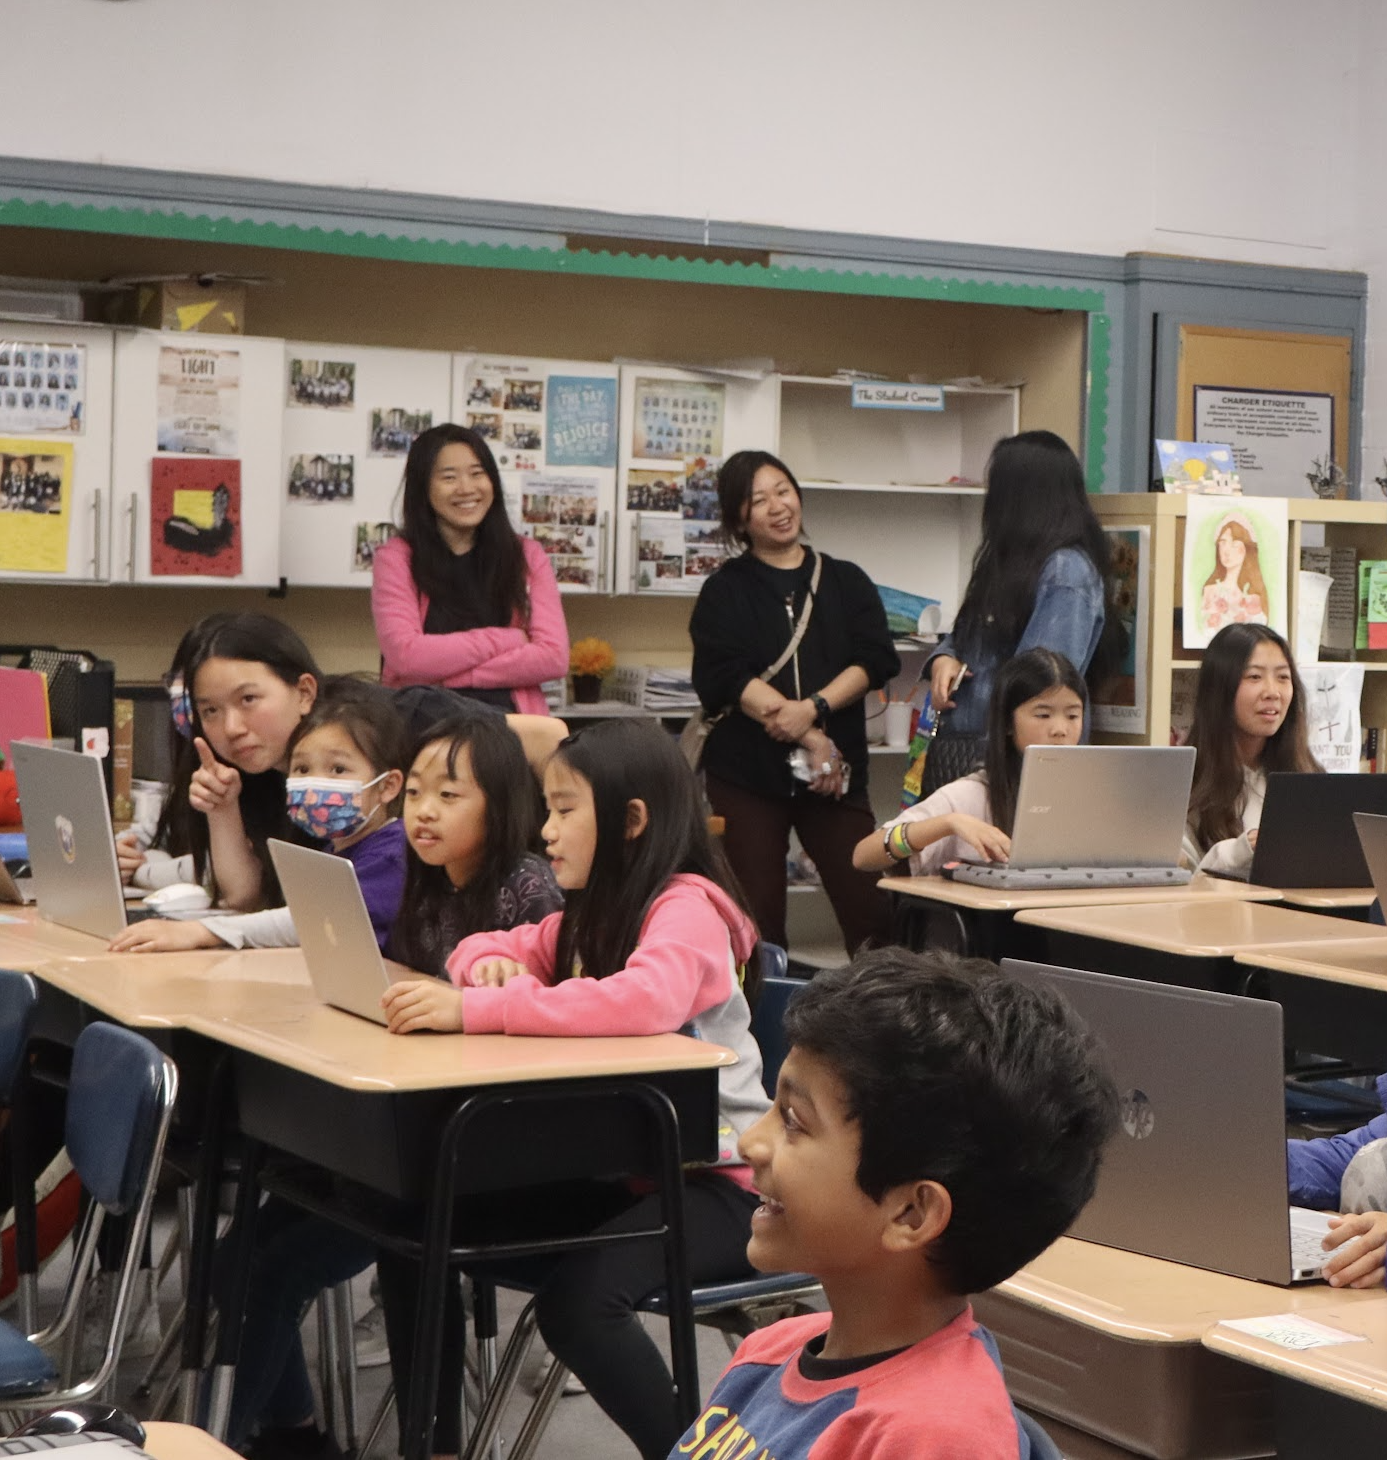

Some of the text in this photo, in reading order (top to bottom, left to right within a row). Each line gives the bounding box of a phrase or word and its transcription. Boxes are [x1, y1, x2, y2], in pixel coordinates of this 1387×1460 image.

[857, 389, 873, 400] The
[1222, 397, 1306, 409] CHARGER ETIQUETTE
[553, 421, 610, 448] REJOICE
[1029, 805, 1052, 814] acer
